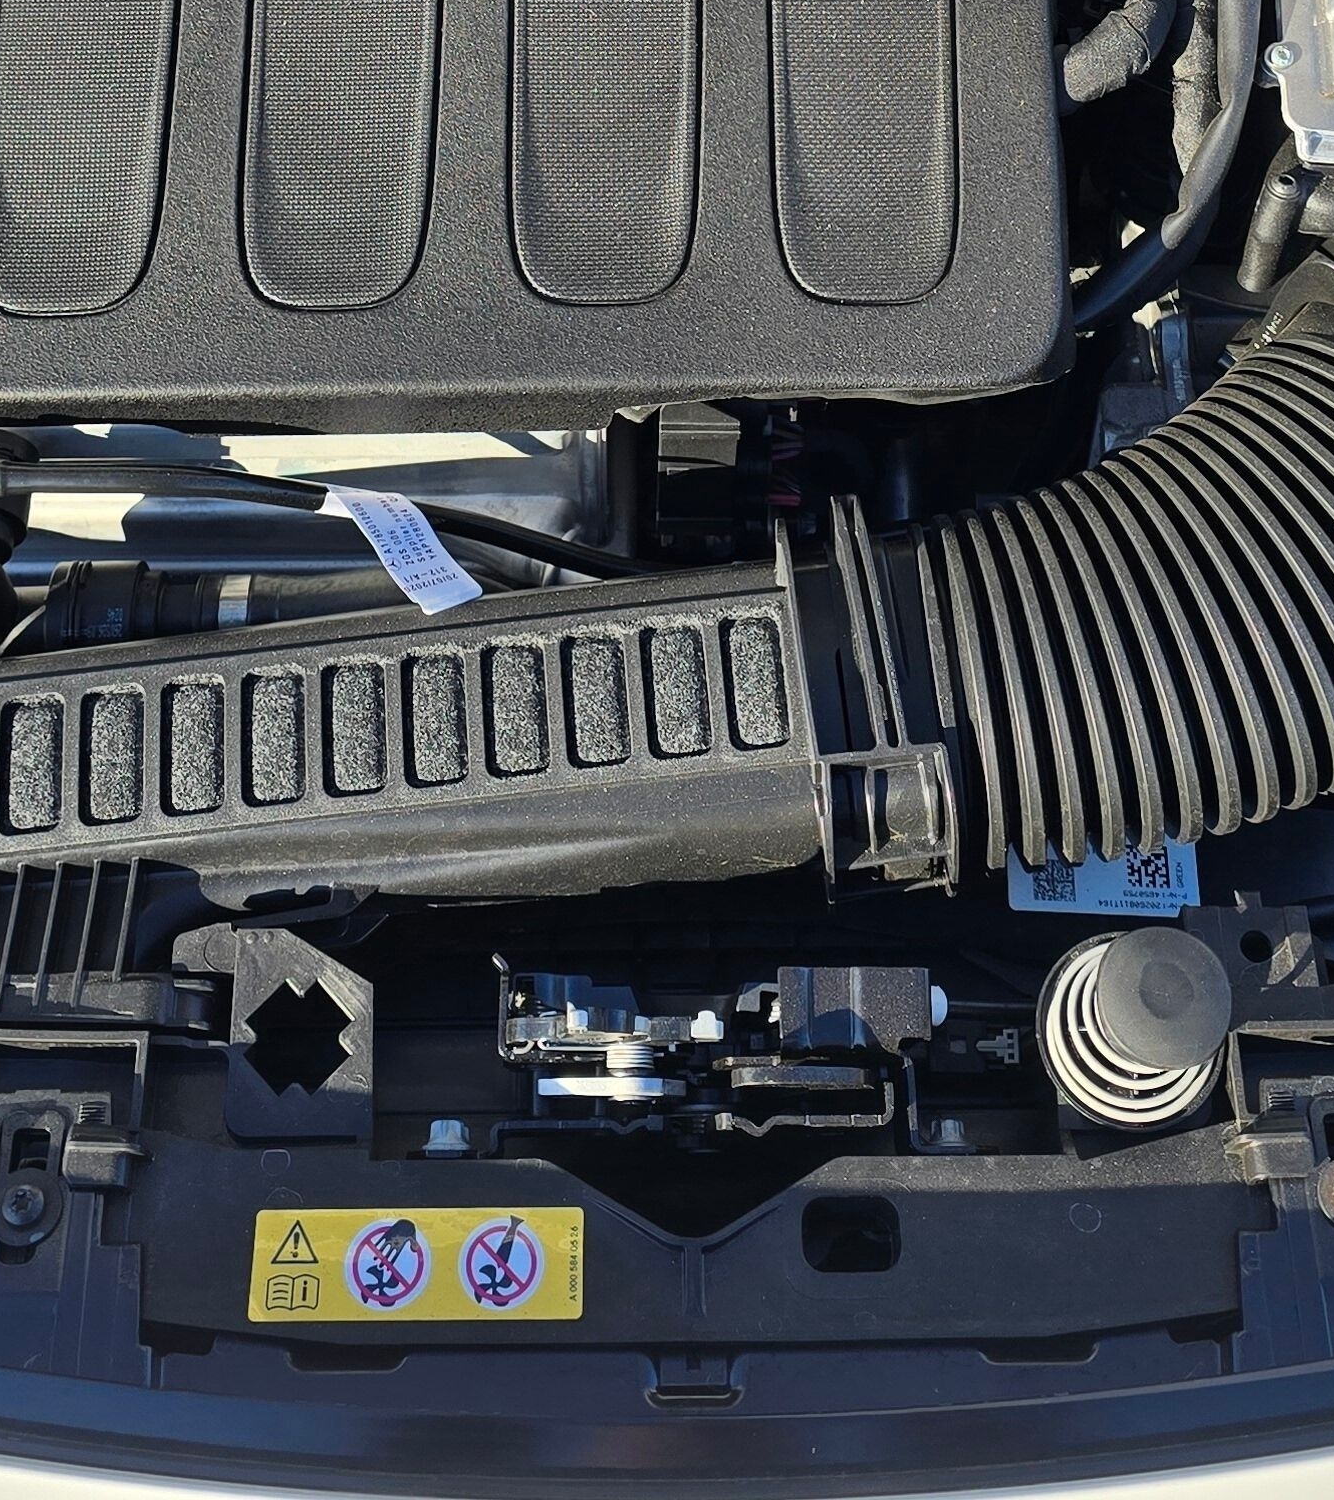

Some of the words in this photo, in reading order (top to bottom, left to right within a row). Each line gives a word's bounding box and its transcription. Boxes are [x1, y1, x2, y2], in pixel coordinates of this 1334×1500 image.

[377, 497, 402, 523] number
[399, 525, 426, 563] Supplier
[398, 548, 415, 566] ZGS
[570, 1225, 579, 1238] 26
[570, 1239, 578, 1252] 05
[570, 1254, 578, 1272] 584
[569, 1274, 578, 1293] 000
[569, 1294, 577, 1302] A
